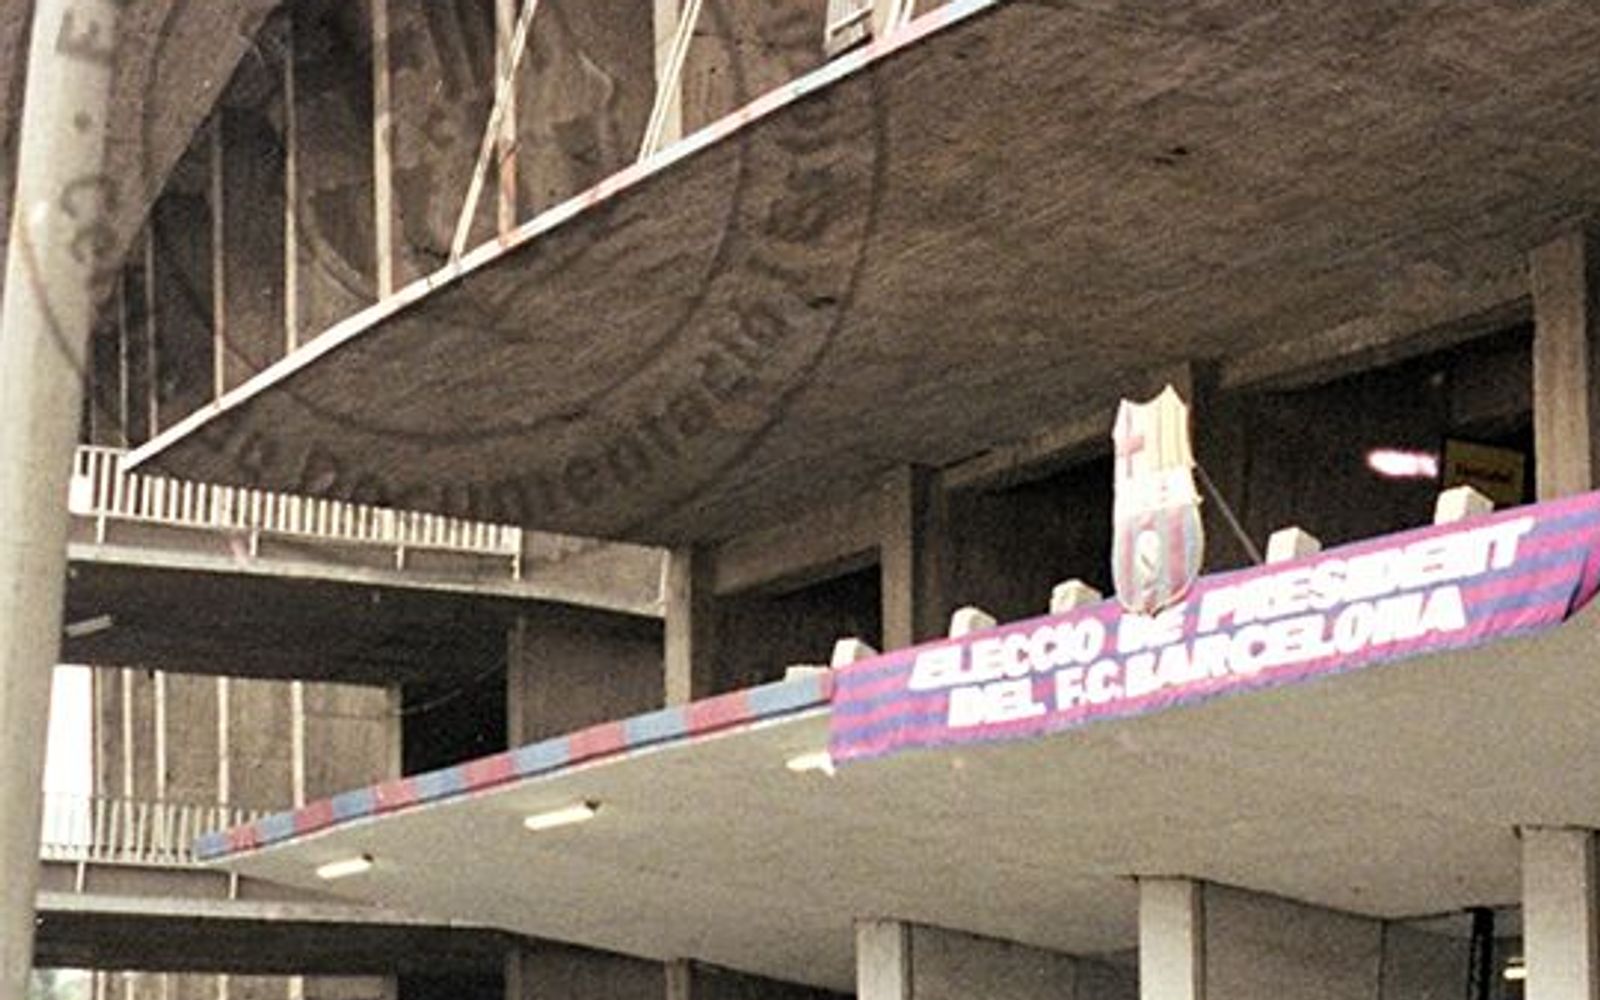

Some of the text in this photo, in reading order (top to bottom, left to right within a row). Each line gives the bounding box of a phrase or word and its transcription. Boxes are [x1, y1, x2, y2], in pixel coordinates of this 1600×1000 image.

[1117, 602, 1188, 653] DE
[1199, 517, 1535, 632] PRESIDENT
[948, 679, 1047, 727] DEL
